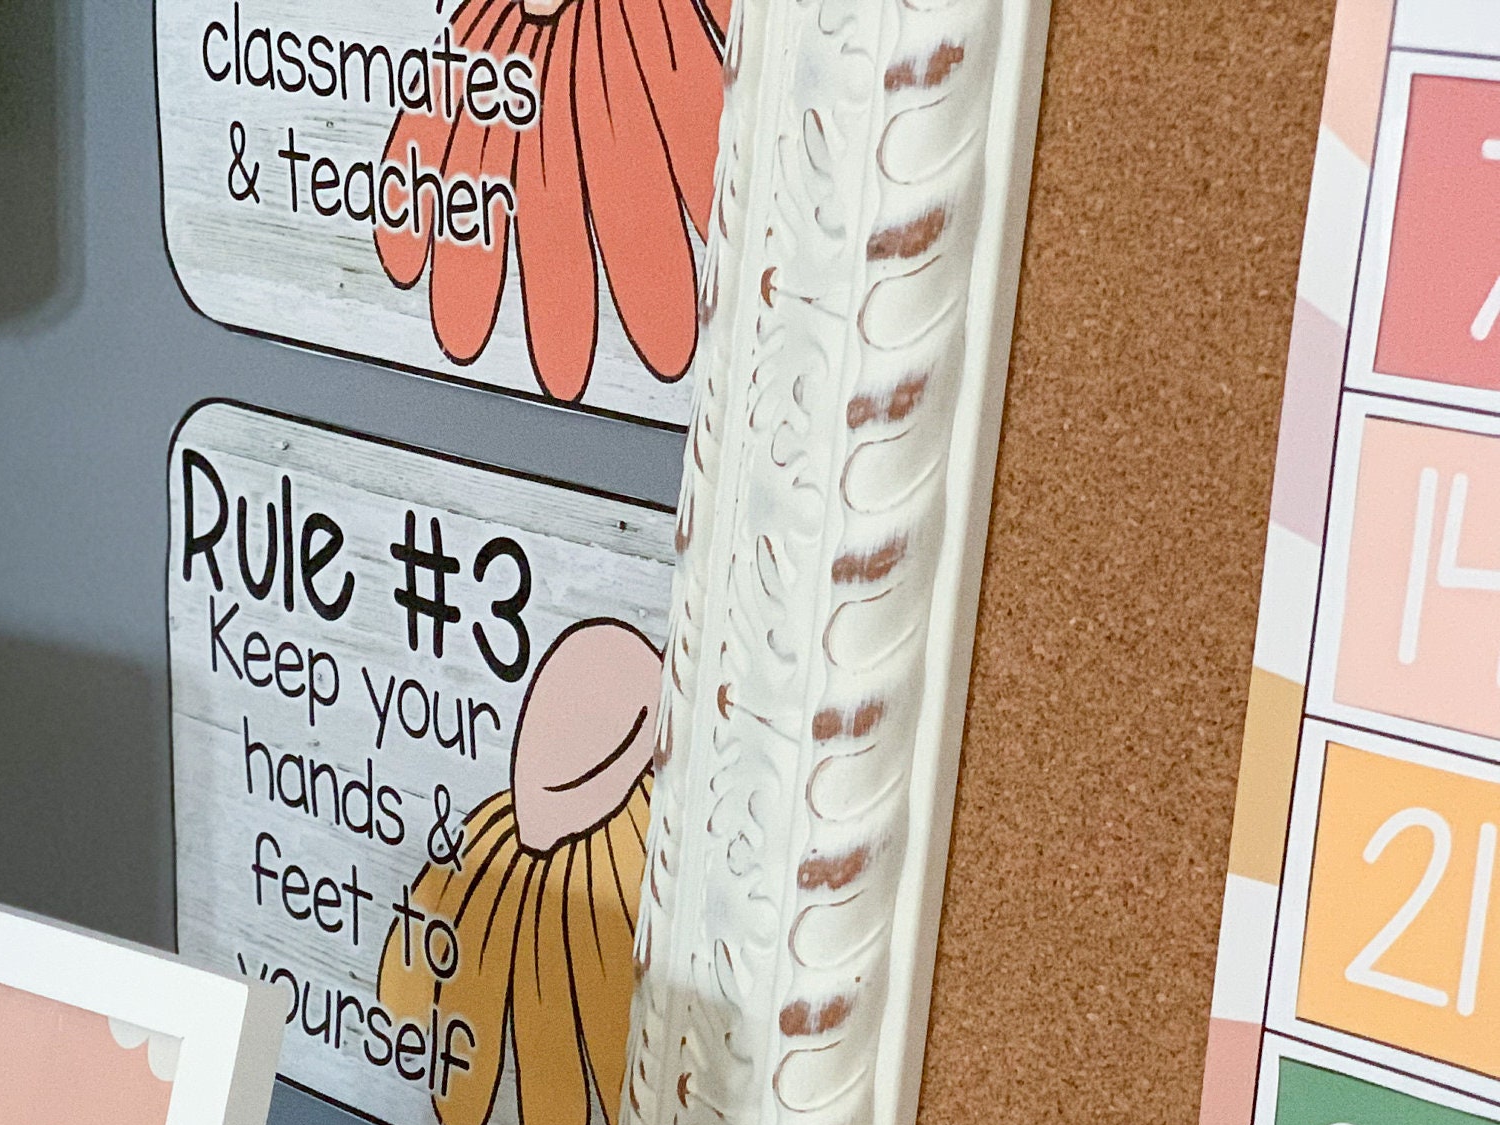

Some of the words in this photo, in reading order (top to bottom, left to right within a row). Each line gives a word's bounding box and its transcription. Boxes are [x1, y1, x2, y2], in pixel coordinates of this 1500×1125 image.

[202, 1, 538, 125] classmates
[228, 120, 260, 203] &
[278, 128, 514, 246] teacher
[181, 448, 355, 622] Rule
[390, 509, 533, 682] #3
[208, 595, 340, 727] Keep
[361, 667, 501, 760] your
[243, 717, 404, 845] hands
[428, 785, 465, 874] &
[252, 832, 373, 946] feet
[392, 884, 458, 979] to
[1344, 806, 1498, 1017] 21
